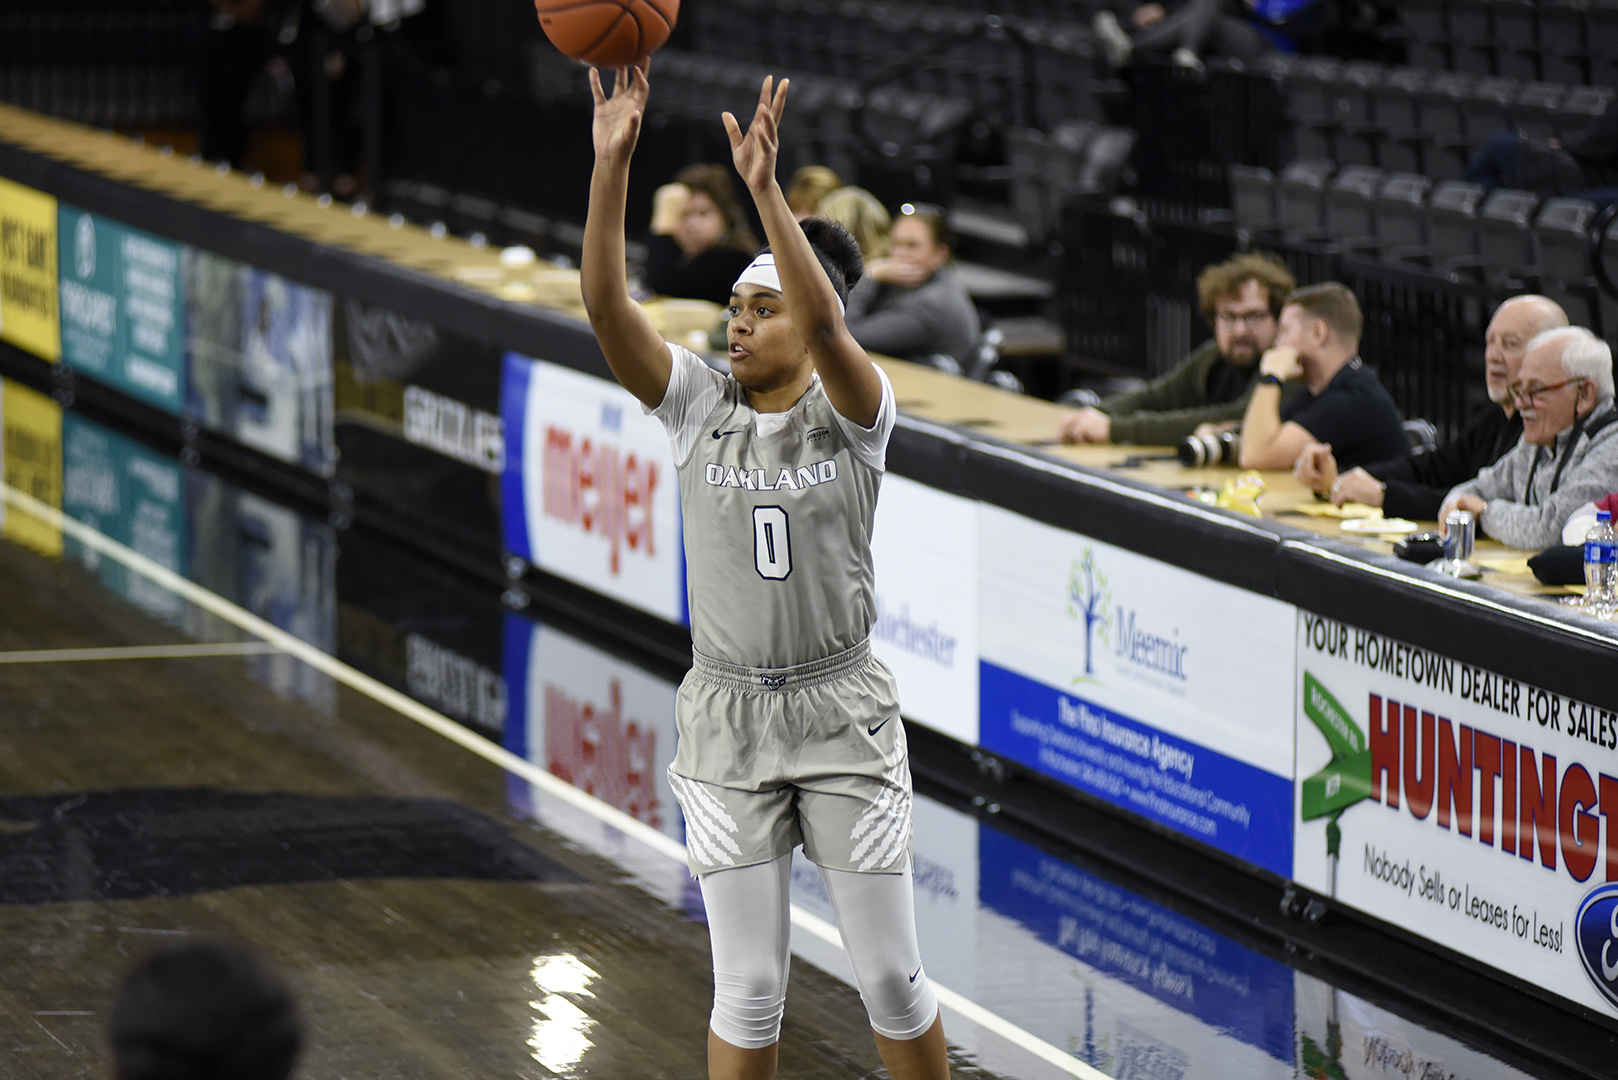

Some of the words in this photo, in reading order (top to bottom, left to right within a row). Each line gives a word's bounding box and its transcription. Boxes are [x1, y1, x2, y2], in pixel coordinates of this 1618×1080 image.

[705, 458, 838, 491] OAKLAND
[752, 505, 793, 581] 0
[1115, 604, 1188, 681] Meemic
[1304, 613, 1348, 662] YOUR
[1354, 628, 1453, 695] HOMETOWN
[1461, 665, 1520, 718] DEALER
[1527, 685, 1560, 731] FOR
[1567, 700, 1618, 751] SALES
[1150, 735, 1194, 781] Agency
[1363, 843, 1415, 898] Nobody
[1418, 865, 1445, 904] Sells
[1448, 887, 1461, 911] or
[1465, 883, 1508, 930] Leases
[1512, 904, 1529, 939] for
[1533, 911, 1563, 953] Less!
